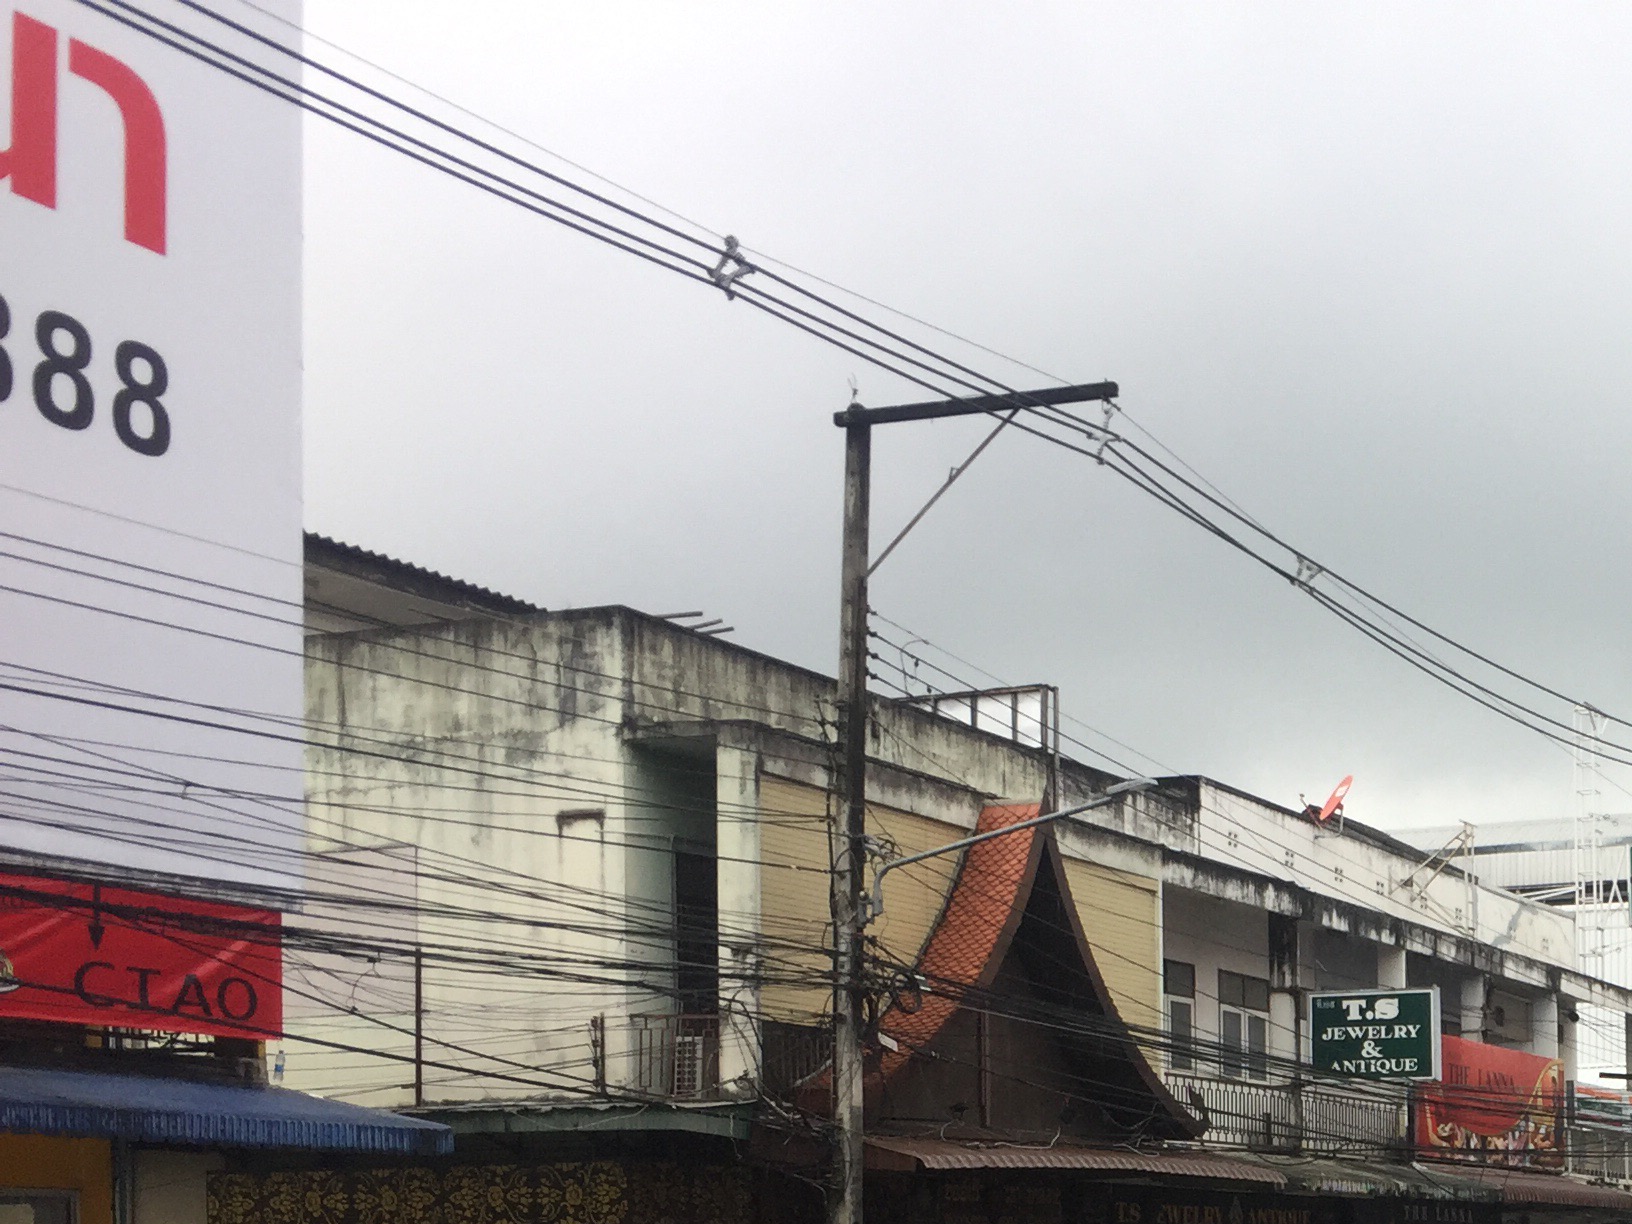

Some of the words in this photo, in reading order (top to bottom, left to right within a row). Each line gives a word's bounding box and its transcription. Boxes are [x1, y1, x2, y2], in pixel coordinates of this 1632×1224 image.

[0, 292, 171, 457] 88
[73, 960, 259, 1022] CIAO
[1341, 998, 1400, 1021] T.S
[1321, 1024, 1422, 1041] JEWELRY
[1361, 1040, 1384, 1058] &
[1331, 1058, 1419, 1074] ANTIQUE
